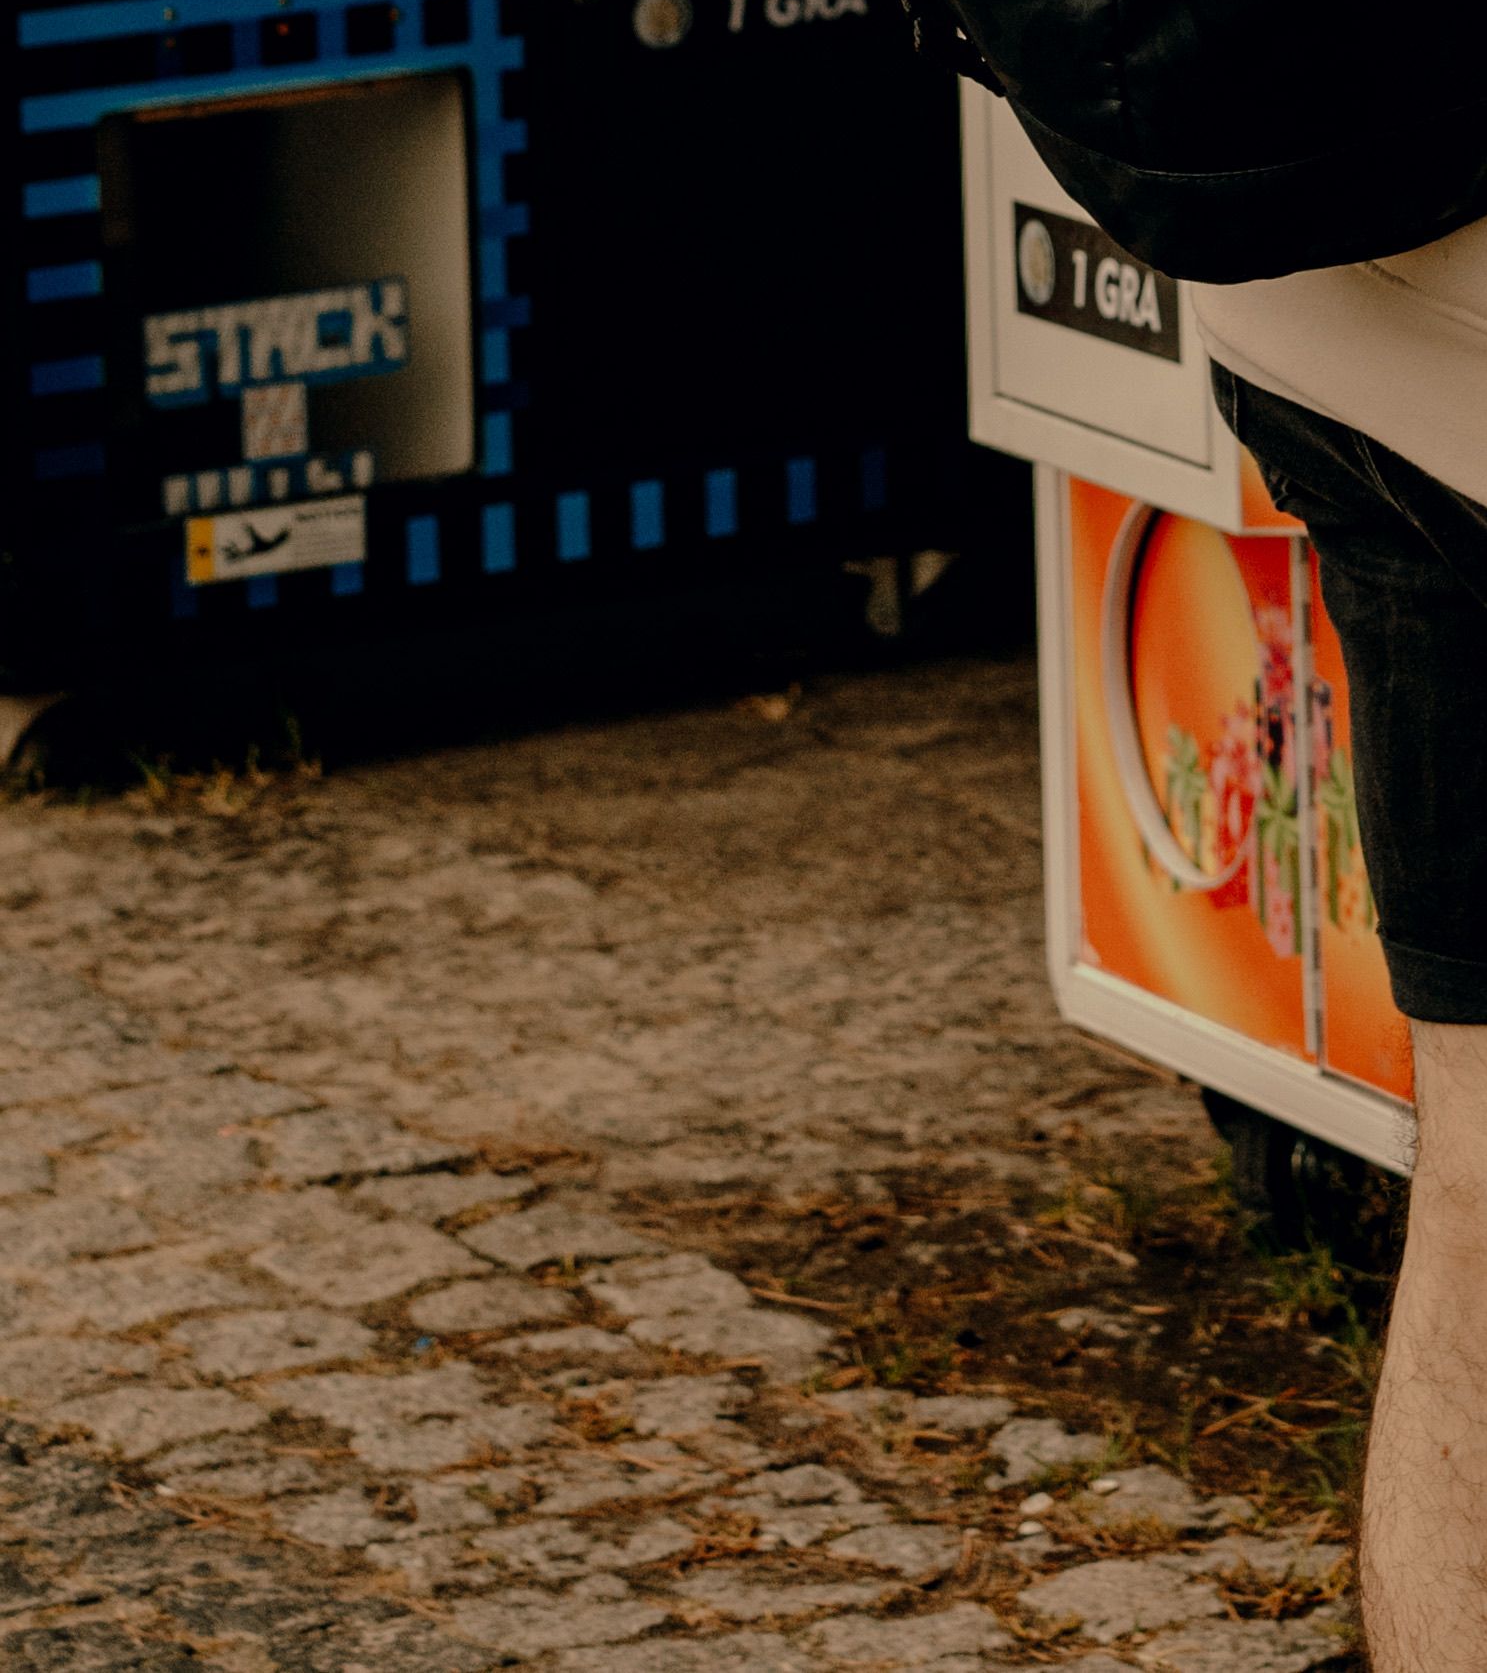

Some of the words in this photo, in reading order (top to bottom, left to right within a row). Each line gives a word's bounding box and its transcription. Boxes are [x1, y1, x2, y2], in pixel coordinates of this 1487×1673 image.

[142, 276, 409, 408] STACK
[1071, 249, 1089, 309] 1
[1099, 252, 1162, 335] GRA
